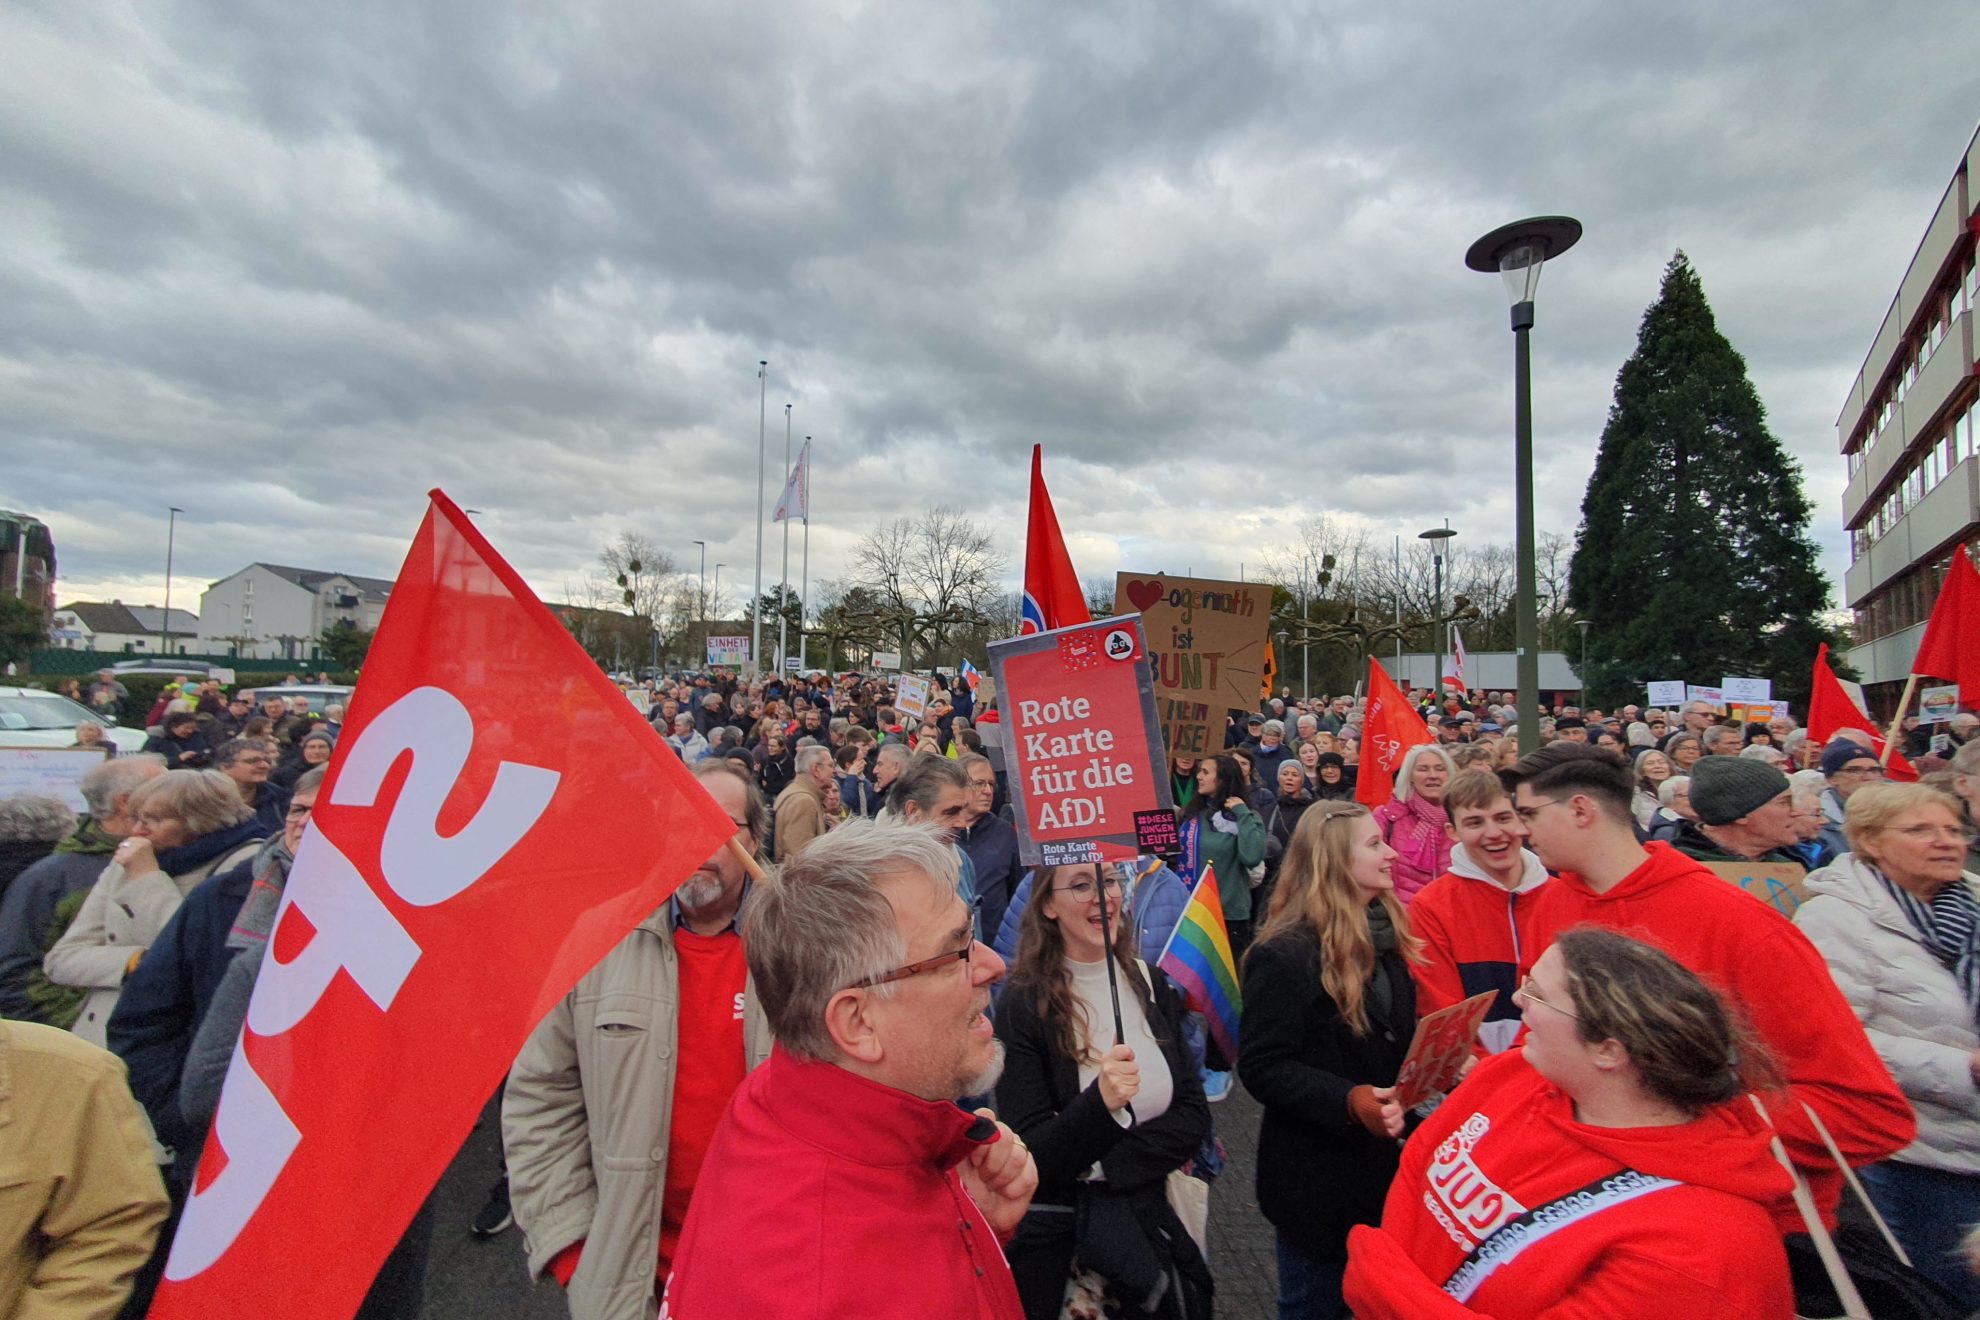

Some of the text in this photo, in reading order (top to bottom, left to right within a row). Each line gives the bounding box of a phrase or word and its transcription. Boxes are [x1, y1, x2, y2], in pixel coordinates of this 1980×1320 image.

[708, 638, 749, 648] EINHEIT
[1172, 625, 1194, 649] ist
[1019, 696, 1091, 728] Rote
[1024, 728, 1114, 762] Karte
[1030, 757, 1134, 796] für die
[1038, 796, 1106, 830] AfD!
[1137, 814, 1173, 824] #DIESE
[1139, 823, 1174, 834] JUNGEN
[1139, 833, 1178, 846] LEUTE
[1043, 841, 1096, 855] Rote Karte
[1044, 852, 1104, 866] für die AfD!
